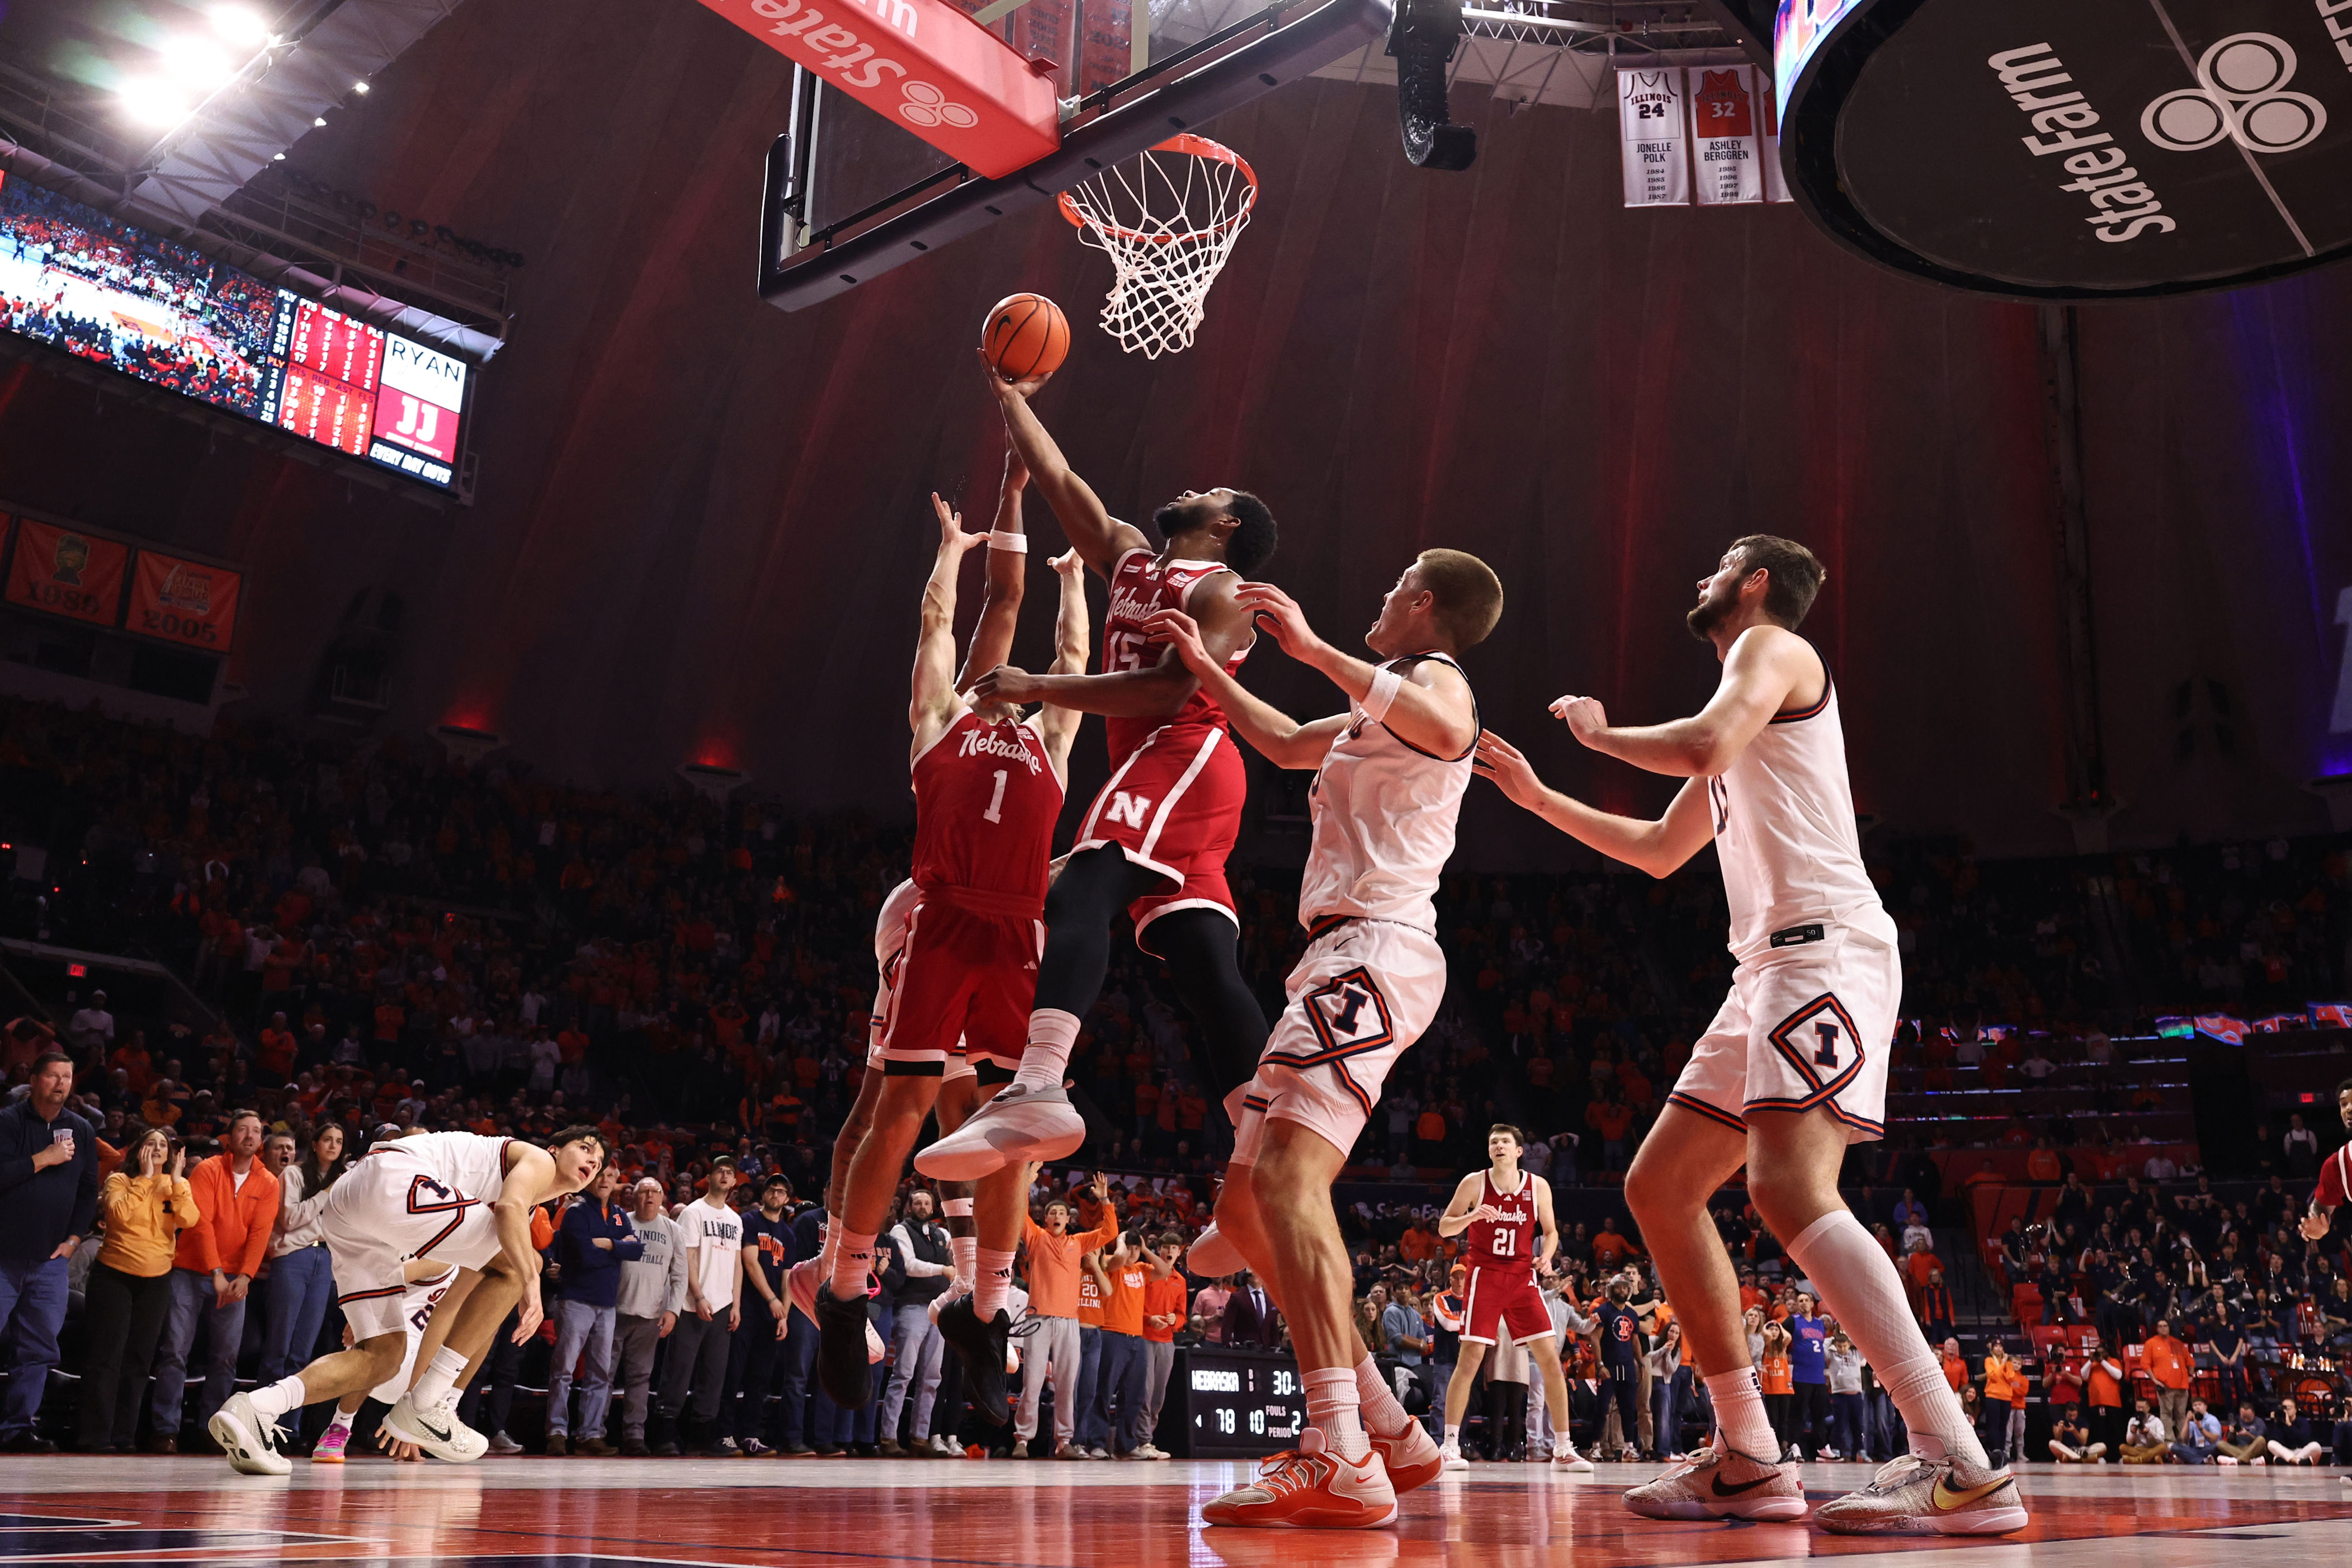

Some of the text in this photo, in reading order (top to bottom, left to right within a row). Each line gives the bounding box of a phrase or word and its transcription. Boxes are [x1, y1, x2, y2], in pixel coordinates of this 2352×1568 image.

[1631, 93, 1672, 106] ILLINOIS
[1639, 103, 1665, 119] 24
[1711, 101, 1736, 118] 32
[1636, 143, 1672, 153] JONELLE
[1709, 140, 1742, 150] ASHLEY
[1643, 153, 1666, 163] POLK
[1704, 150, 1749, 162] BERGGREN
[300, 321, 311, 332] 11
[304, 311, 311, 320] 7
[325, 322, 333, 330] 4
[370, 340, 377, 348] 4
[344, 318, 364, 331] AST
[319, 362, 327, 371] 7
[392, 340, 460, 382] RYAN
[267, 355, 374, 403] PLY PTS REB AST FLS
[267, 390, 275, 400] 4
[396, 395, 438, 442] JJ
[141, 610, 218, 643] 2005
[1108, 631, 1146, 673] 15
[958, 729, 1042, 776] Nebraska
[983, 769, 1008, 824] 1
[1106, 791, 1151, 830] N
[1332, 982, 1367, 1036] I
[1815, 1022, 1838, 1069] I
[1493, 1227, 1515, 1256] 21
[1082, 1283, 1098, 1297] 20
[1078, 1298, 1101, 1309] ILLINI
[1812, 1340, 1821, 1353] 2
[1192, 1370, 1239, 1392] NEBRASKA
[1216, 1405, 1301, 1435] 78 10 FOULS 2
[1268, 1427, 1291, 1438] PERIOD
